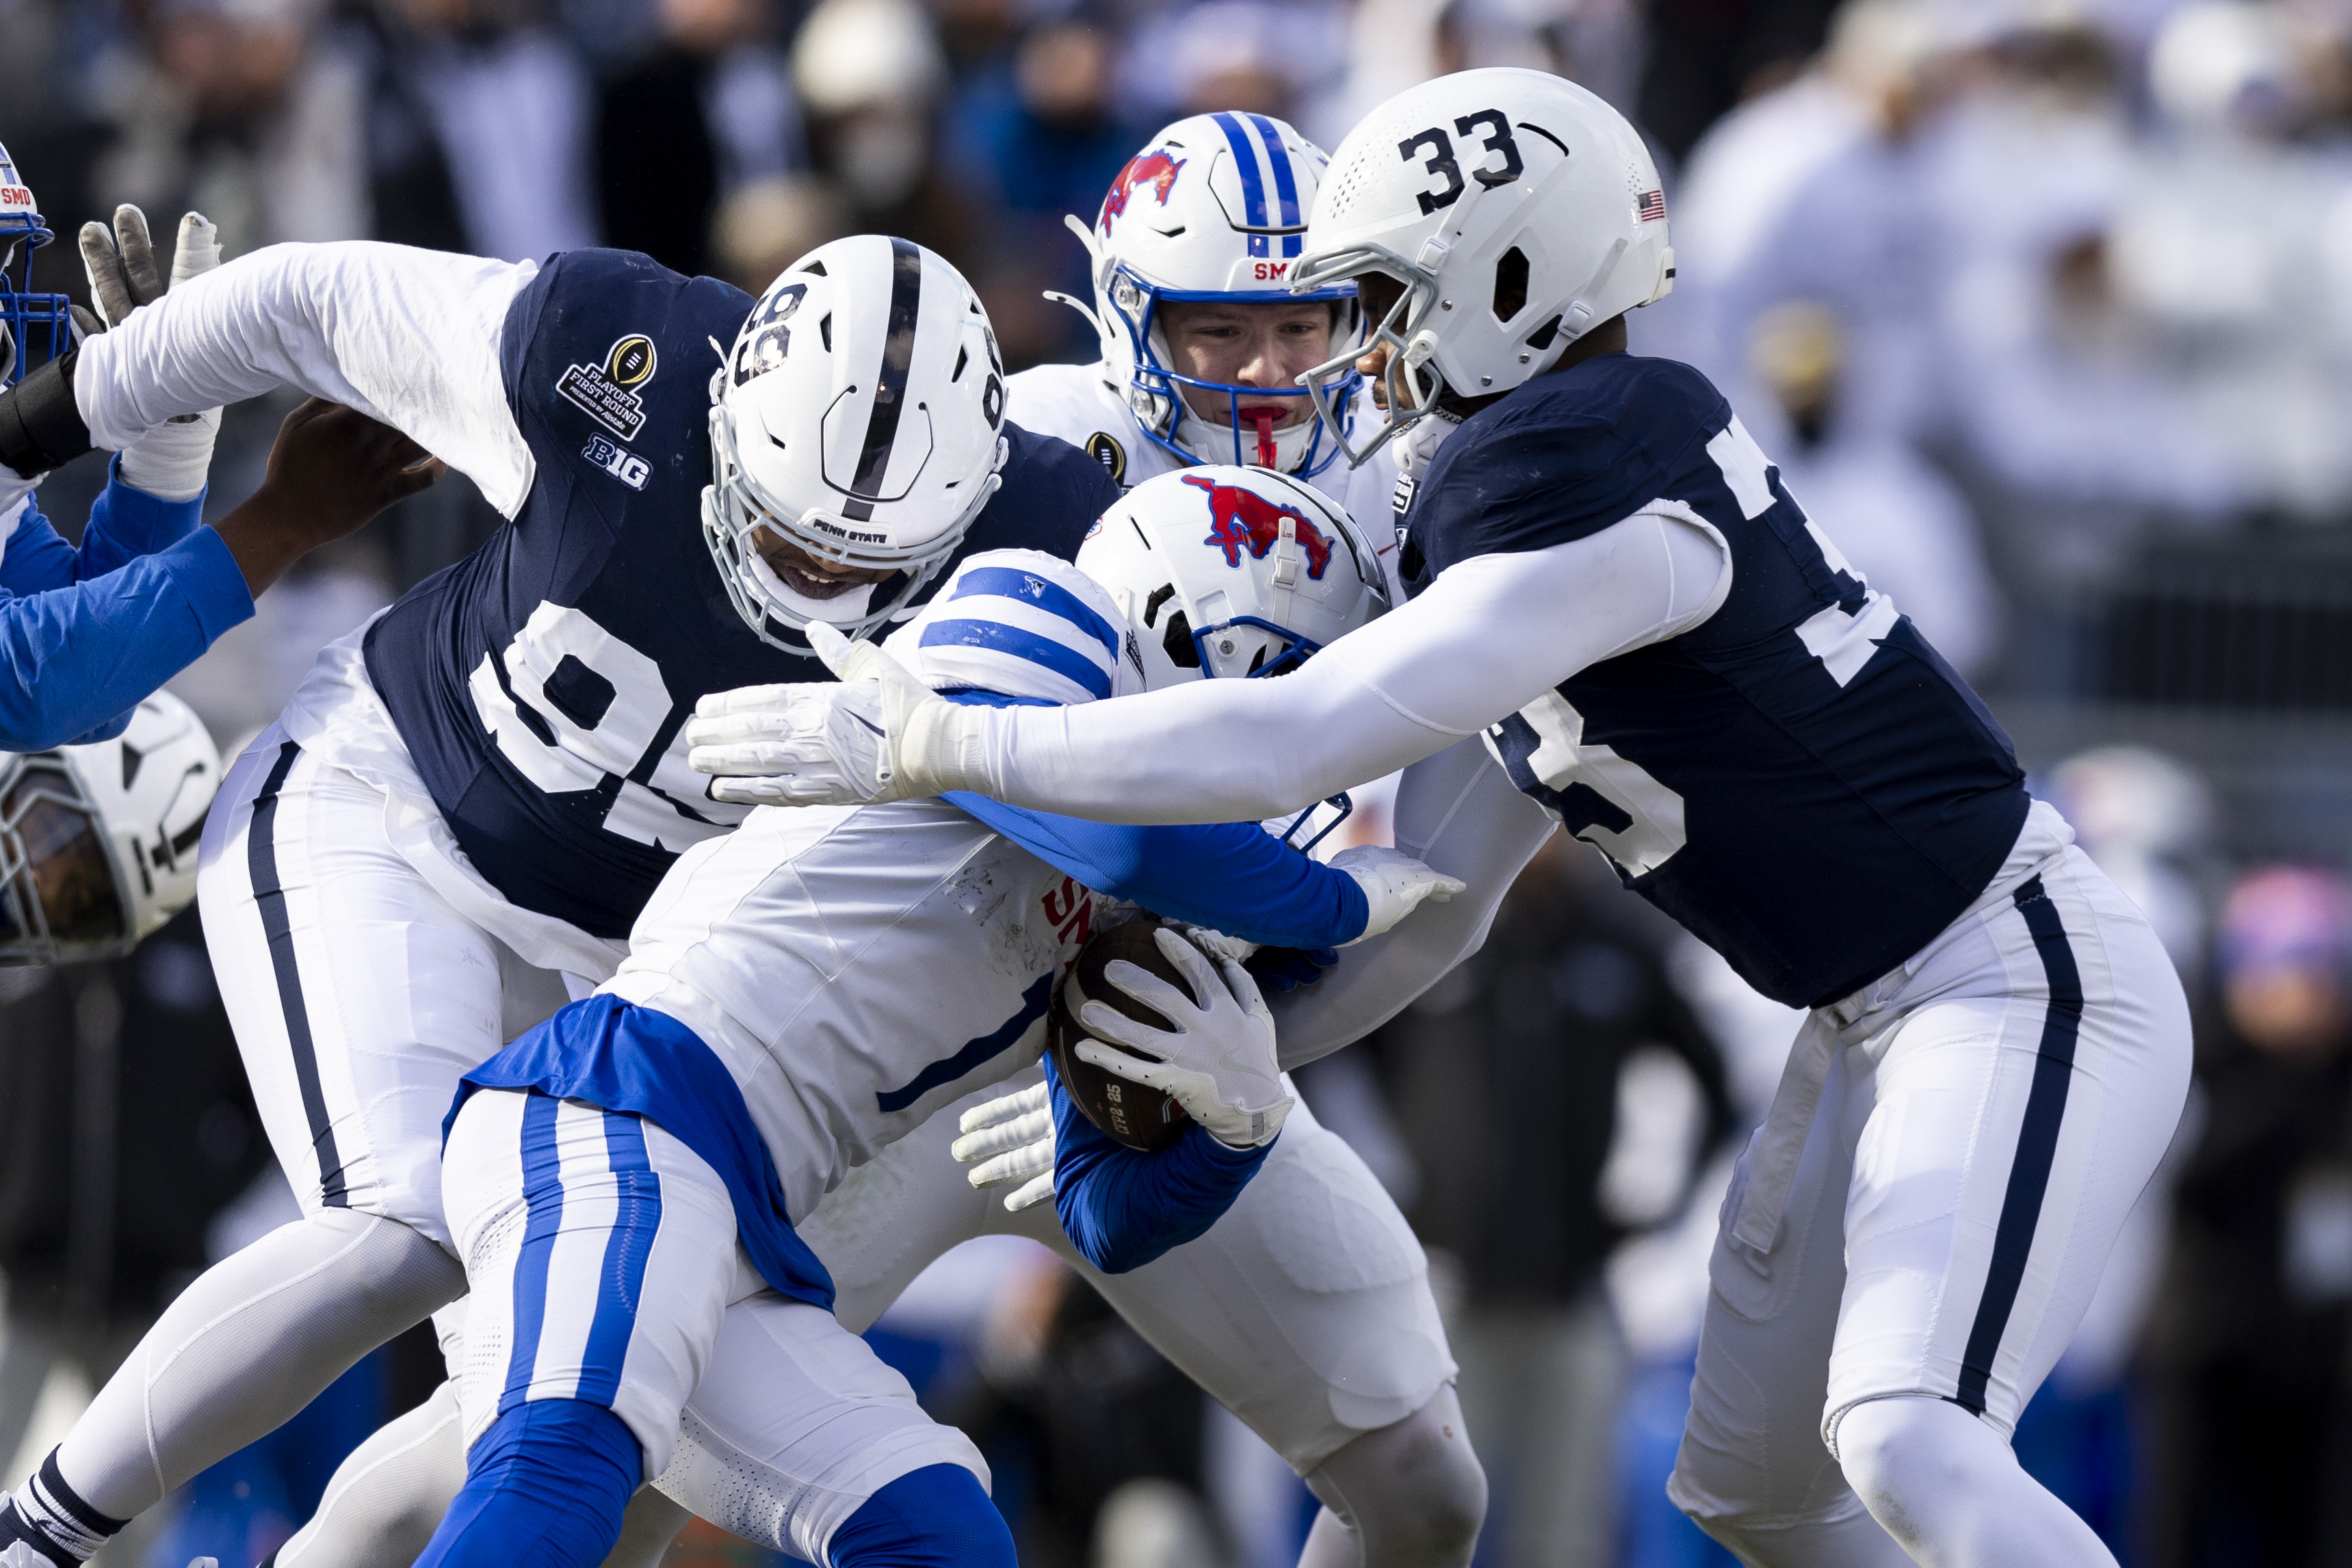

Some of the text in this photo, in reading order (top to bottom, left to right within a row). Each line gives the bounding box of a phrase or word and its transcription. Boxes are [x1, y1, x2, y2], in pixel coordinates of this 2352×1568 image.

[1398, 108, 1524, 217] 33
[1254, 263, 1288, 280] SM
[569, 371, 639, 426] FIRST ROUND
[569, 386, 626, 430] PRESENTED BY Allstate
[588, 371, 636, 408] PLAYOFF
[813, 518, 887, 544] PENN STATE
